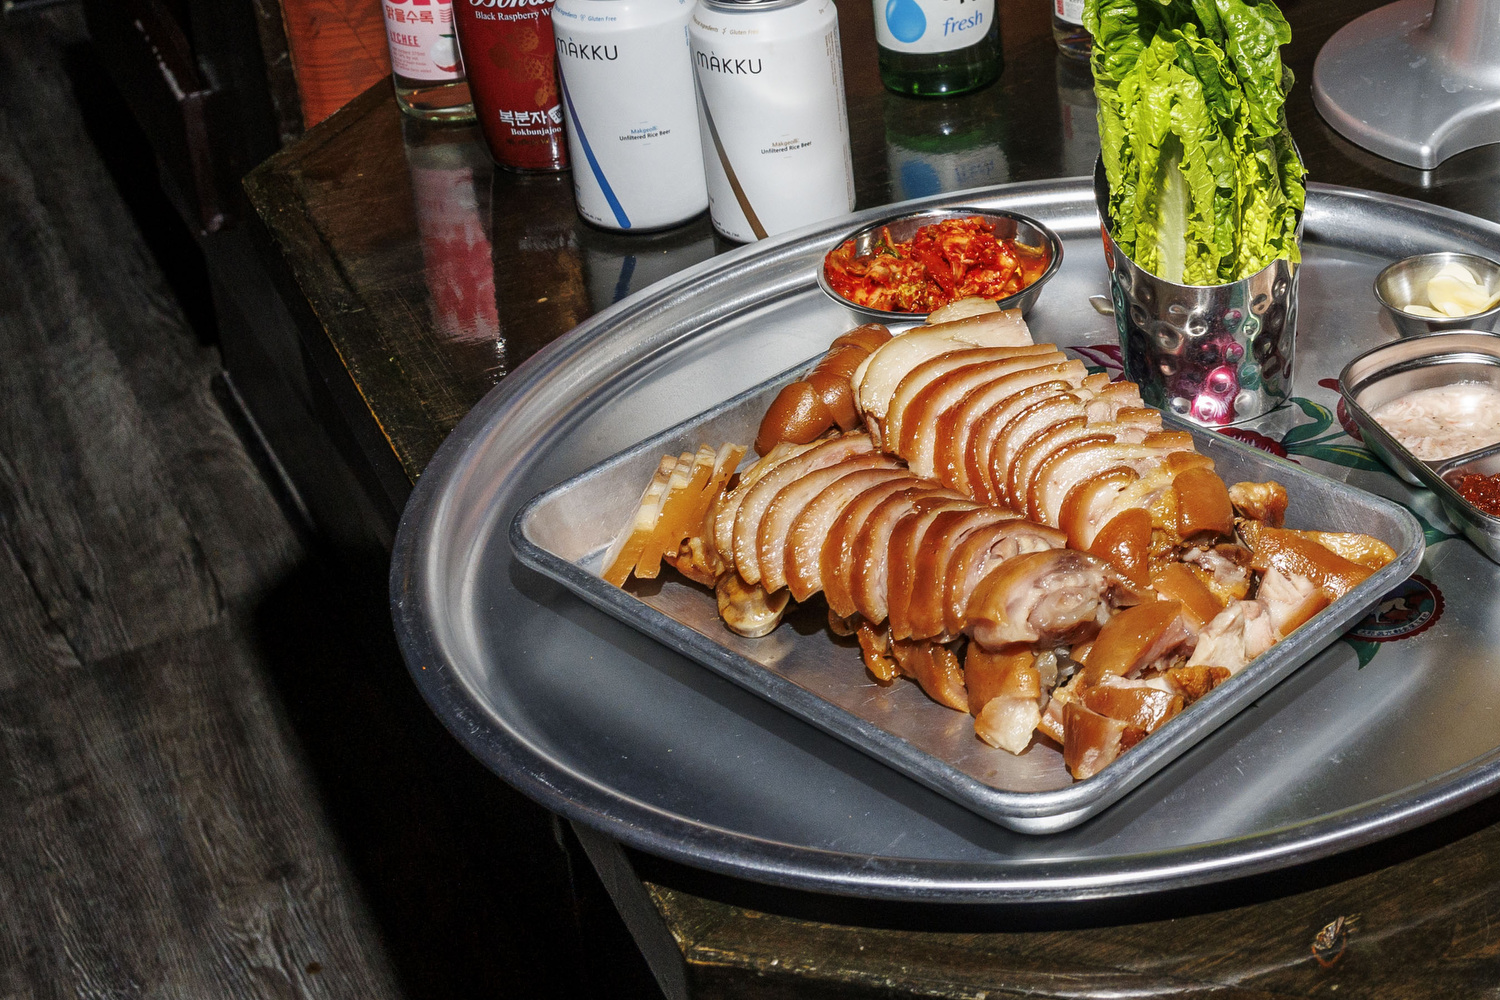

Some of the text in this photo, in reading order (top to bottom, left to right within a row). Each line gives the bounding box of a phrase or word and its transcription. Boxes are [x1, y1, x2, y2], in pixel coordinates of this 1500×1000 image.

[475, 10, 496, 20] Black
[497, 11, 539, 22] Raspberry
[942, 10, 983, 37] fresh
[390, 30, 418, 46] LYCHEE
[499, 109, 547, 126] 복분자
[511, 126, 562, 136] Bokbunjajoo
[619, 134, 646, 142] Unfiltered
[760, 140, 812, 155] Unfiltered Rice Beer
